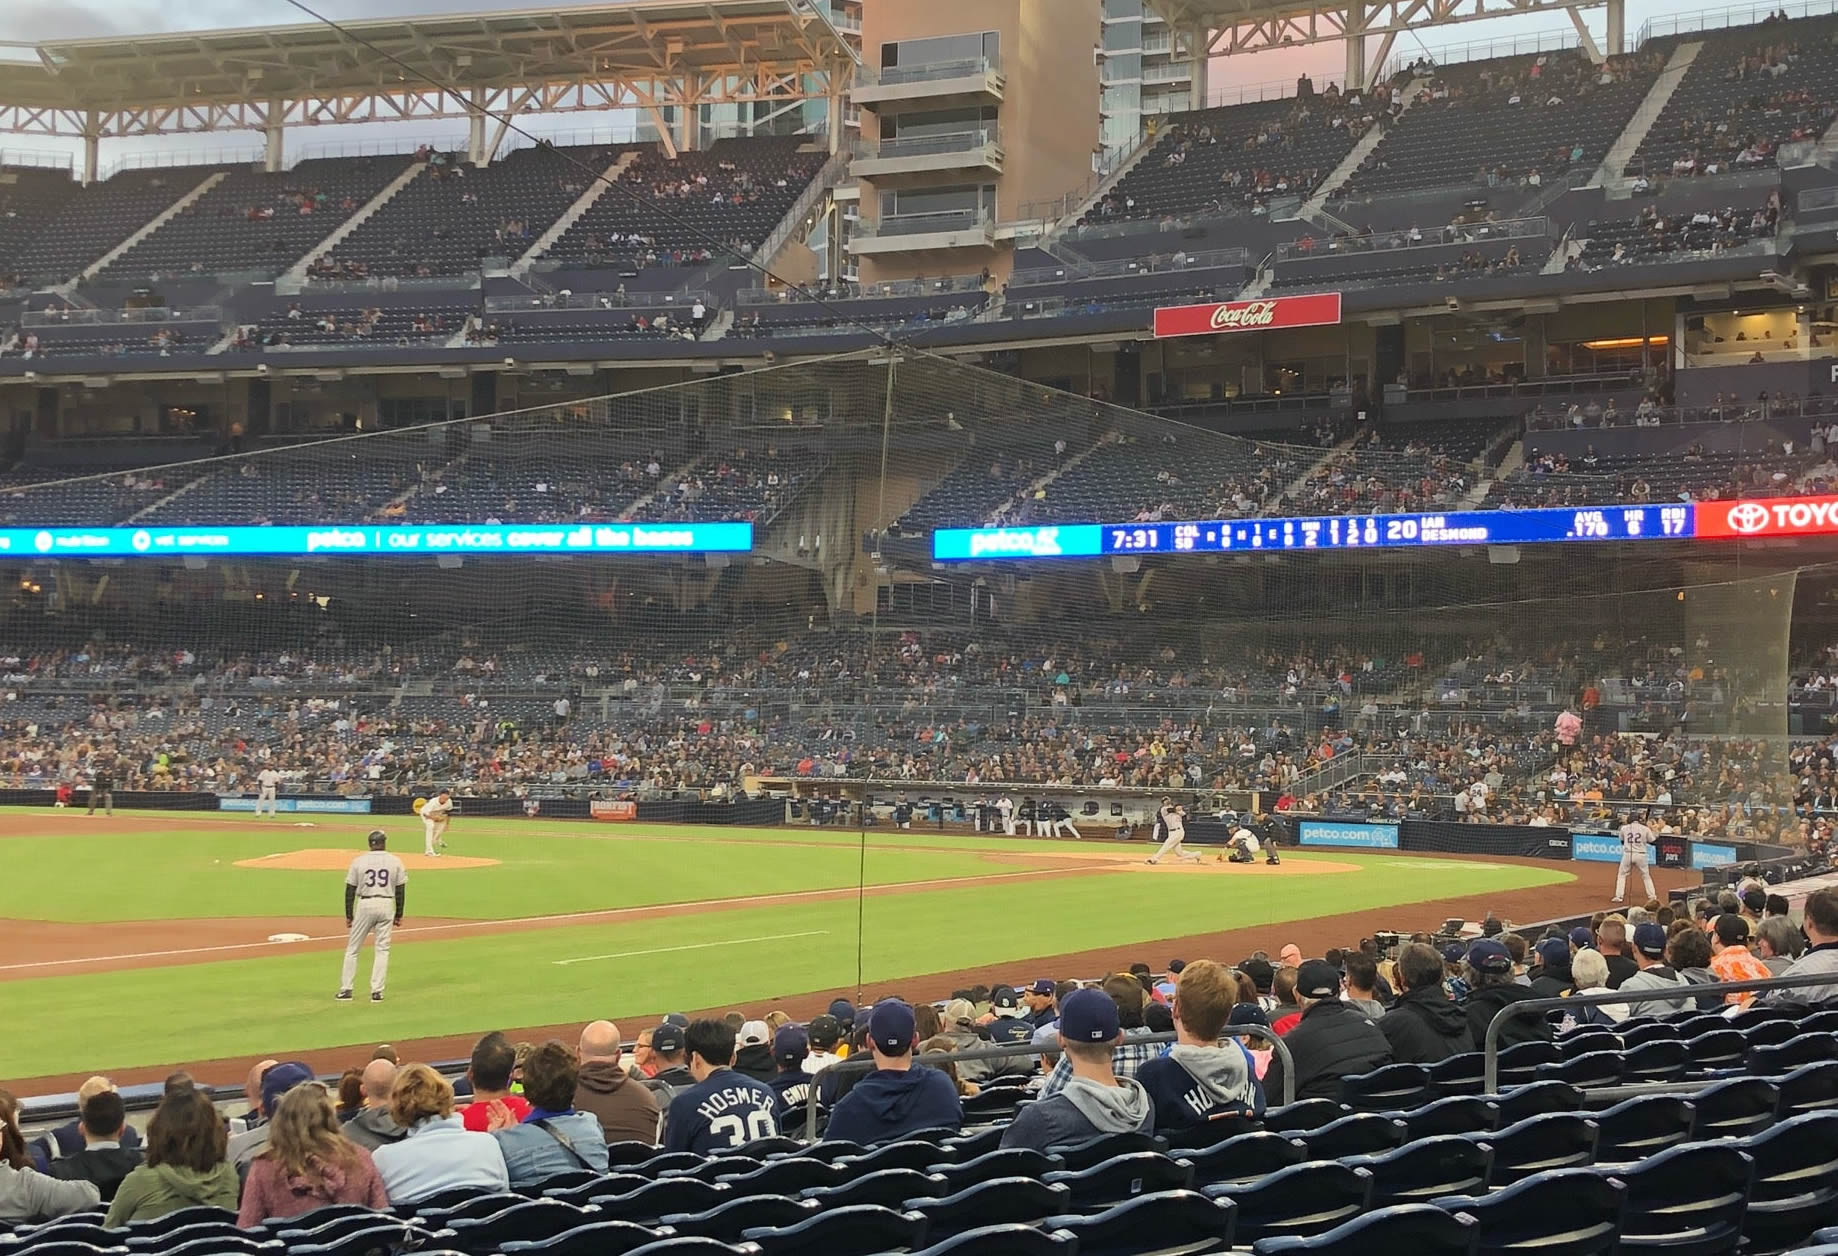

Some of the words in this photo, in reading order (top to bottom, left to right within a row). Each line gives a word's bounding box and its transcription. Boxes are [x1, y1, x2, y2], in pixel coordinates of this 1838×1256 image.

[1211, 301, 1276, 329] Coca-Cola
[1421, 517, 1445, 528] IAN
[1574, 511, 1602, 522] AVG
[1624, 510, 1643, 521] HR
[1661, 508, 1686, 520] RBI
[1175, 525, 1200, 537] COL
[1254, 523, 1261, 534] 1
[1207, 531, 1215, 541] R
[1237, 530, 1246, 540] H
[1269, 529, 1277, 539] E
[1387, 520, 1417, 539] 20
[1421, 527, 1488, 541] DESMOND
[1567, 521, 1608, 537] .170
[1662, 519, 1685, 534] 17
[307, 528, 366, 552] petco
[388, 532, 420, 547] our
[426, 529, 503, 547] services
[507, 532, 564, 547] cover
[567, 526, 593, 546] all
[595, 528, 630, 546] the
[1112, 530, 1157, 549] 7:31
[1175, 537, 1194, 549] SD
[1252, 535, 1262, 547] 0
[1305, 531, 1317, 546] 2
[1330, 529, 1339, 544] 1
[1347, 528, 1359, 544] 2
[1364, 528, 1378, 544] 0
[1303, 828, 1369, 840] petco.com
[1627, 832, 1641, 844] 22
[1576, 841, 1624, 855] petco.co
[364, 869, 389, 887] 39
[697, 1087, 774, 1120] HOSMER
[710, 1109, 777, 1147] 30
